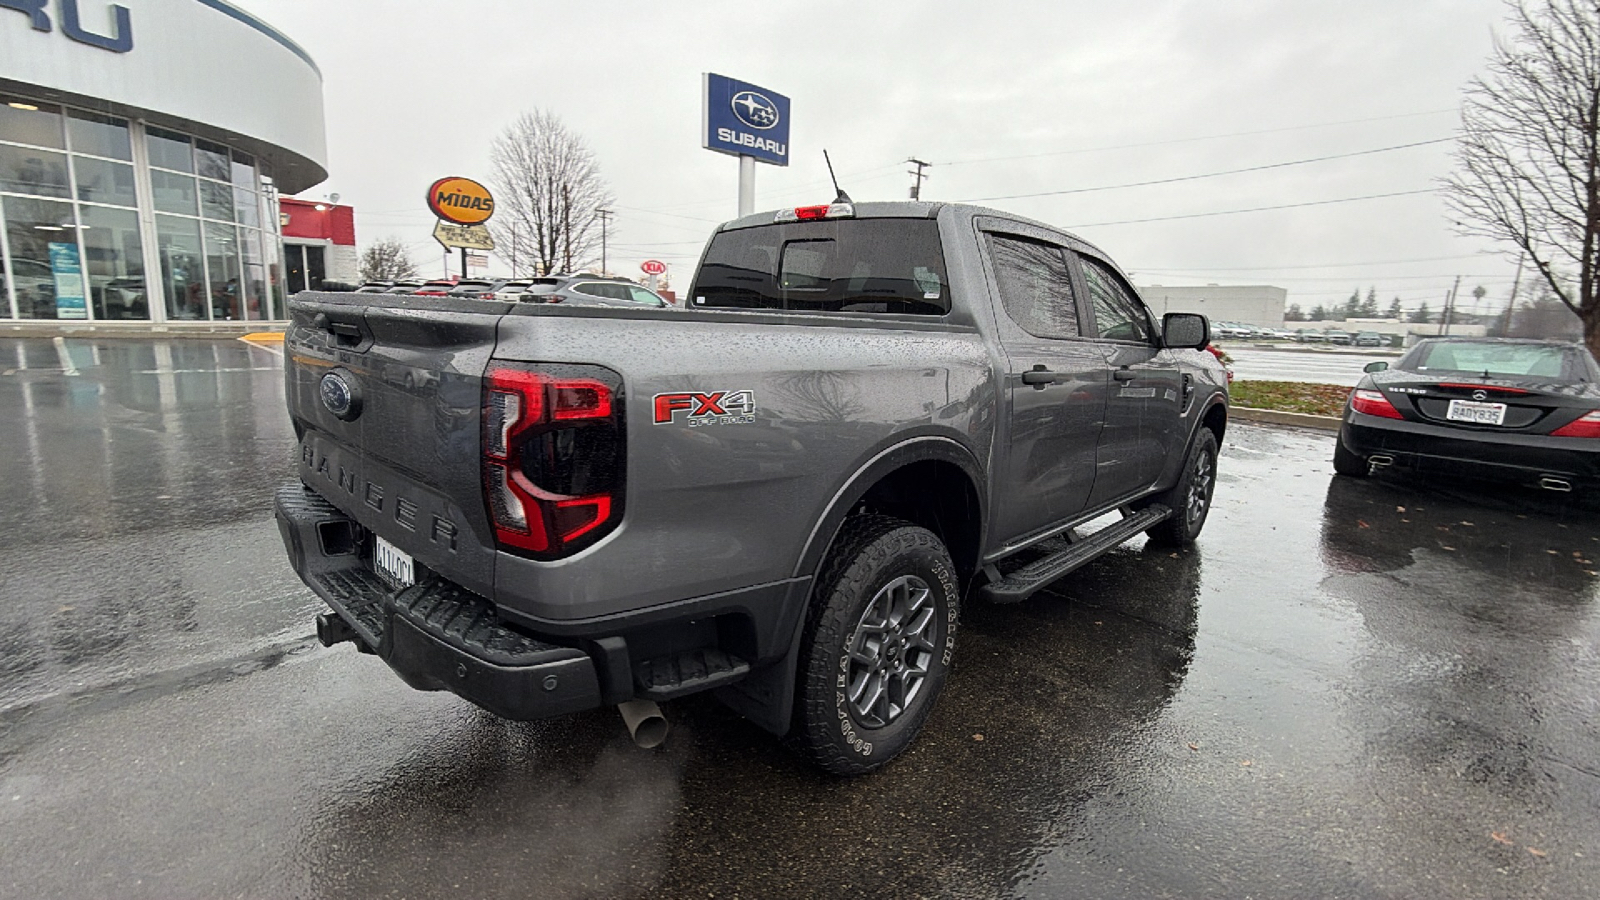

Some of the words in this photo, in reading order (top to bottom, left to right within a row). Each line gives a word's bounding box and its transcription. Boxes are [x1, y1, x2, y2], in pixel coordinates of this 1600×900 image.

[717, 127, 786, 156] SUBARU
[437, 190, 493, 211] MIDAS
[646, 262, 663, 273] KIA
[652, 389, 756, 425] FX4
[688, 417, 717, 428] OFF
[302, 445, 458, 554] RANGER
